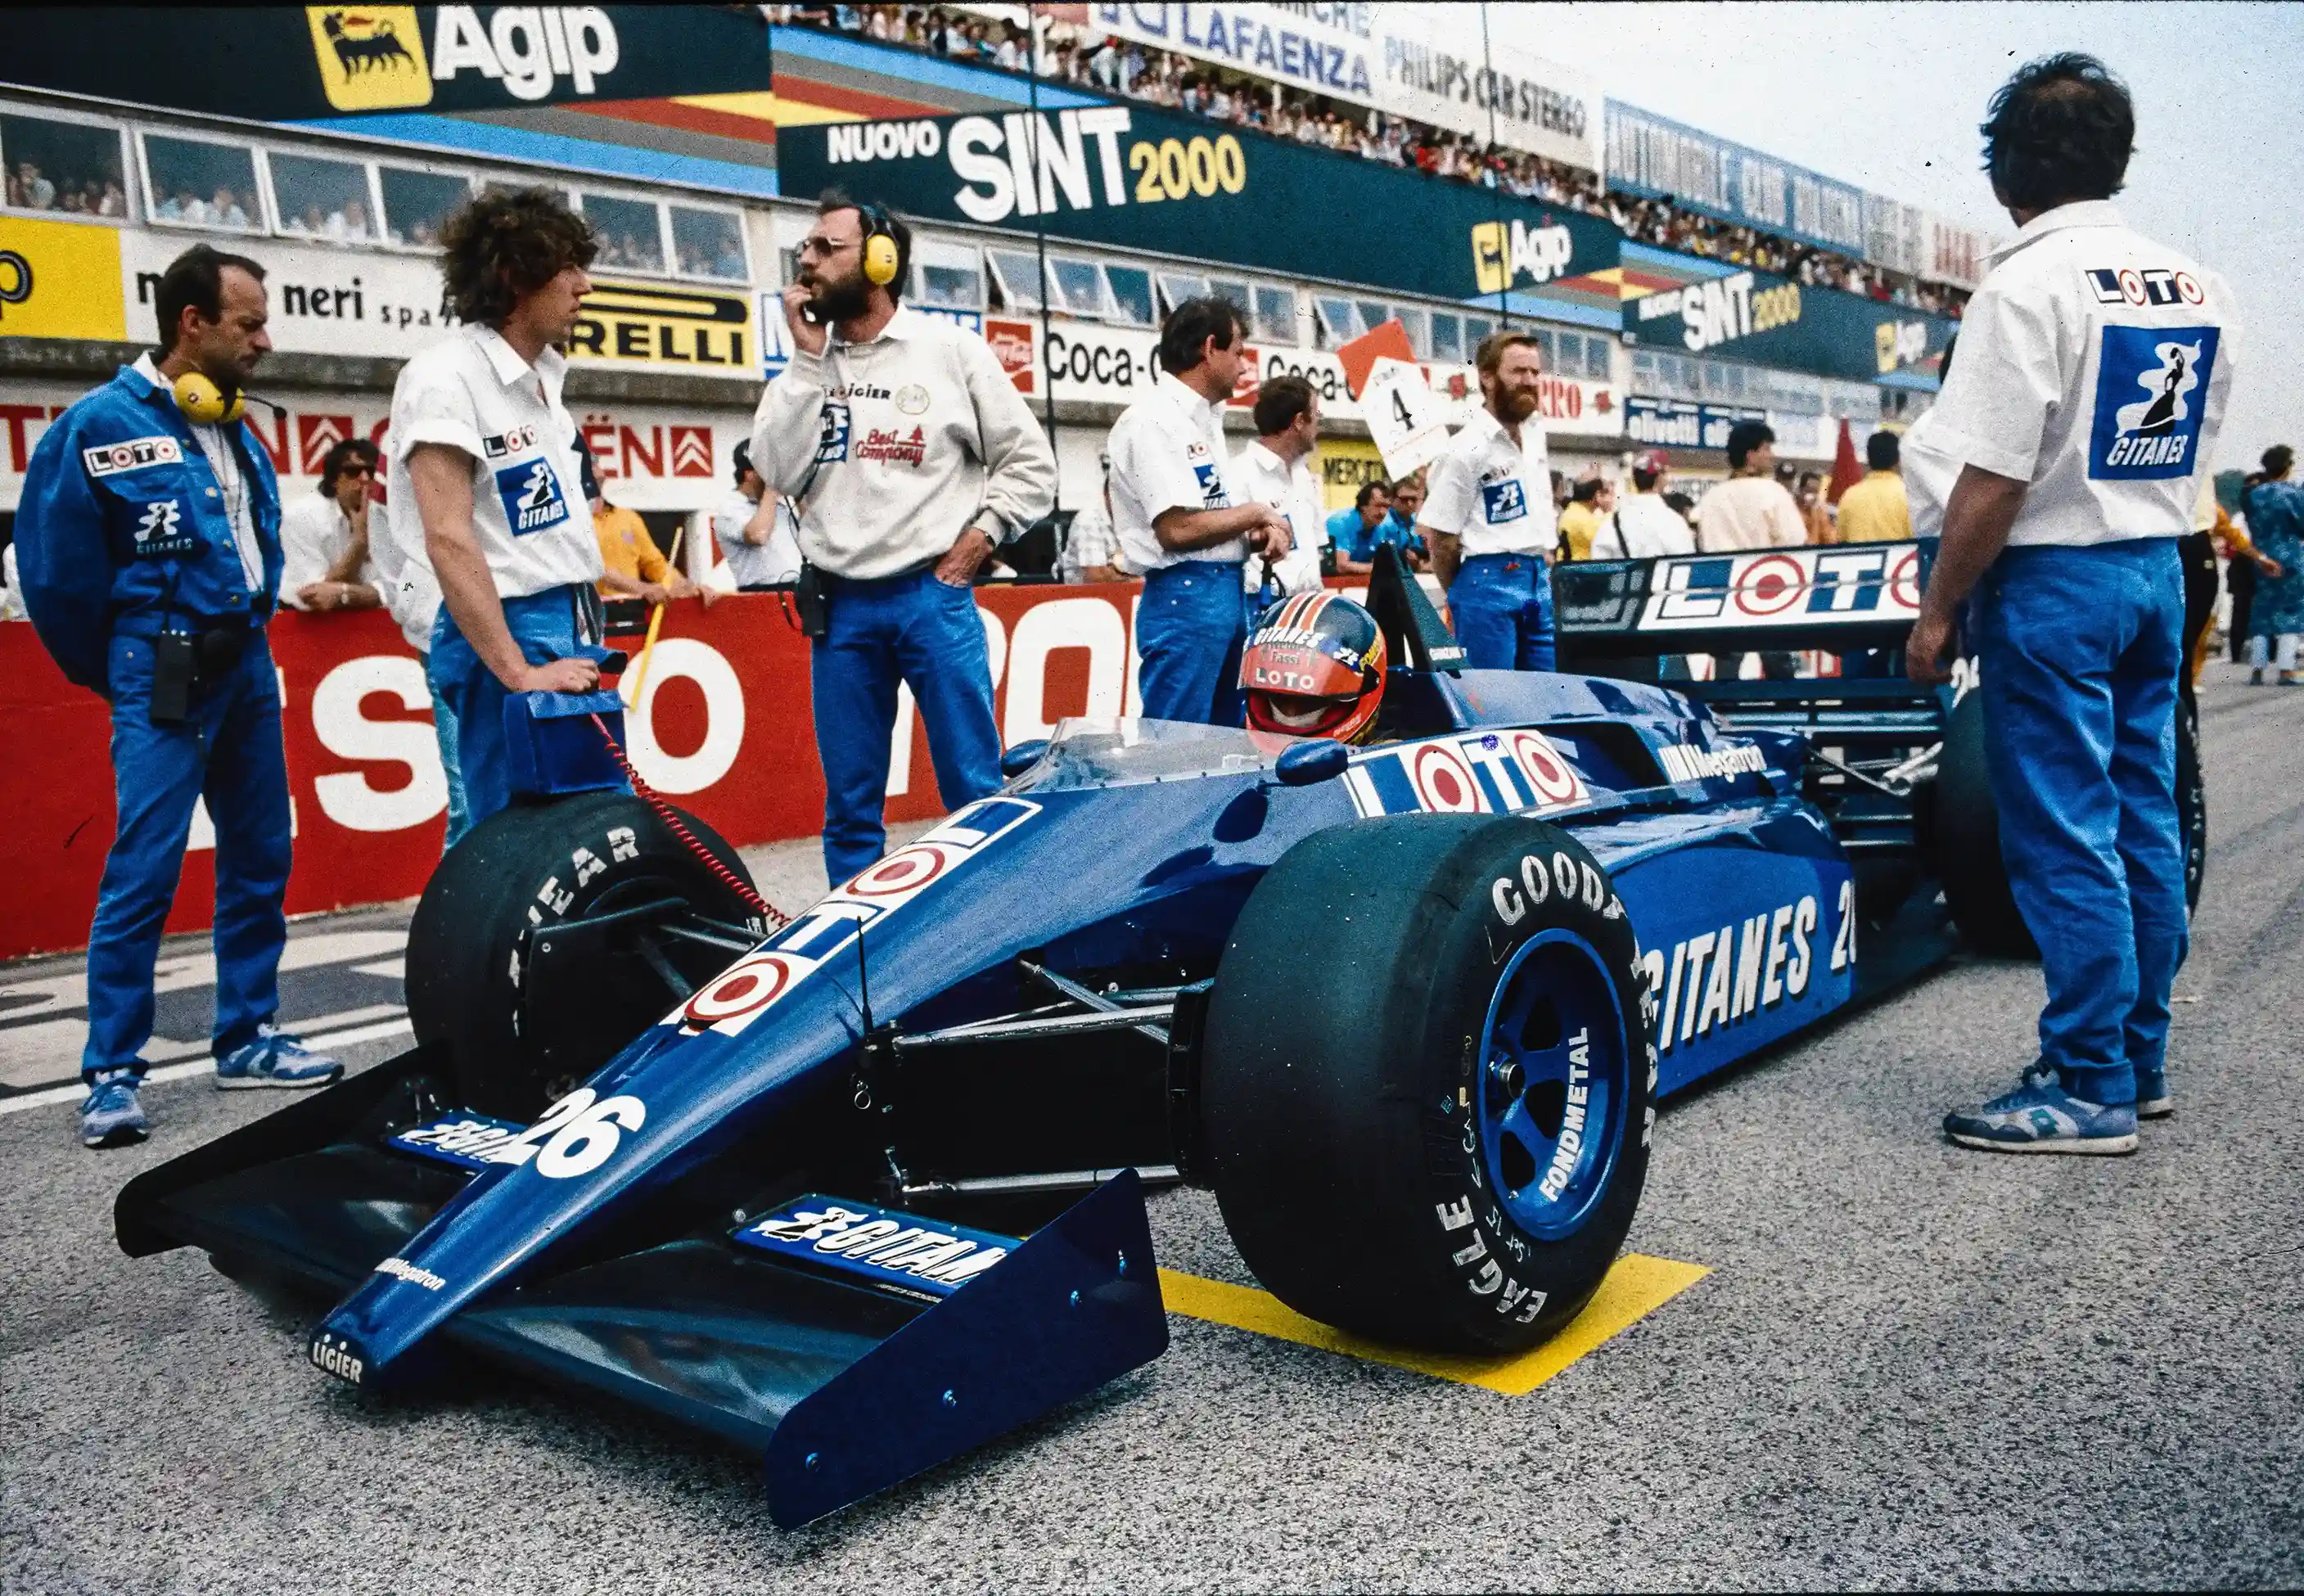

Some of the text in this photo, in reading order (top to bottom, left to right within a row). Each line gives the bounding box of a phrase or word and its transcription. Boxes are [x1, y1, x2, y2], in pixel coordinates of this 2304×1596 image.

[433, 5, 620, 100] Agip
[1384, 36, 1471, 103] PHILIPS
[1518, 78, 1586, 139] STEREO
[827, 106, 1246, 223] NUOVO SINT 2000
[2085, 268, 2205, 306] LOTO
[1681, 272, 1755, 351] SINT
[568, 318, 745, 365] RELLI
[1044, 331, 1162, 386] Coca-
[848, 382, 891, 400] IGIER
[1392, 387, 1415, 432] 4
[88, 440, 177, 472] LOTO
[855, 440, 927, 467] Company
[868, 427, 899, 445] Best
[2105, 434, 2189, 467] GITANES
[136, 537, 194, 555] GITANES
[1254, 626, 1326, 649] GITANES
[1256, 667, 1315, 690] LOTO
[1349, 730, 1578, 818] LOTO
[489, 1087, 647, 1179] 26
[1538, 1026, 1589, 1202] FONDMETAL
[813, 1220, 1008, 1284] GITAN
[1436, 1194, 1549, 1323] EAGLE
